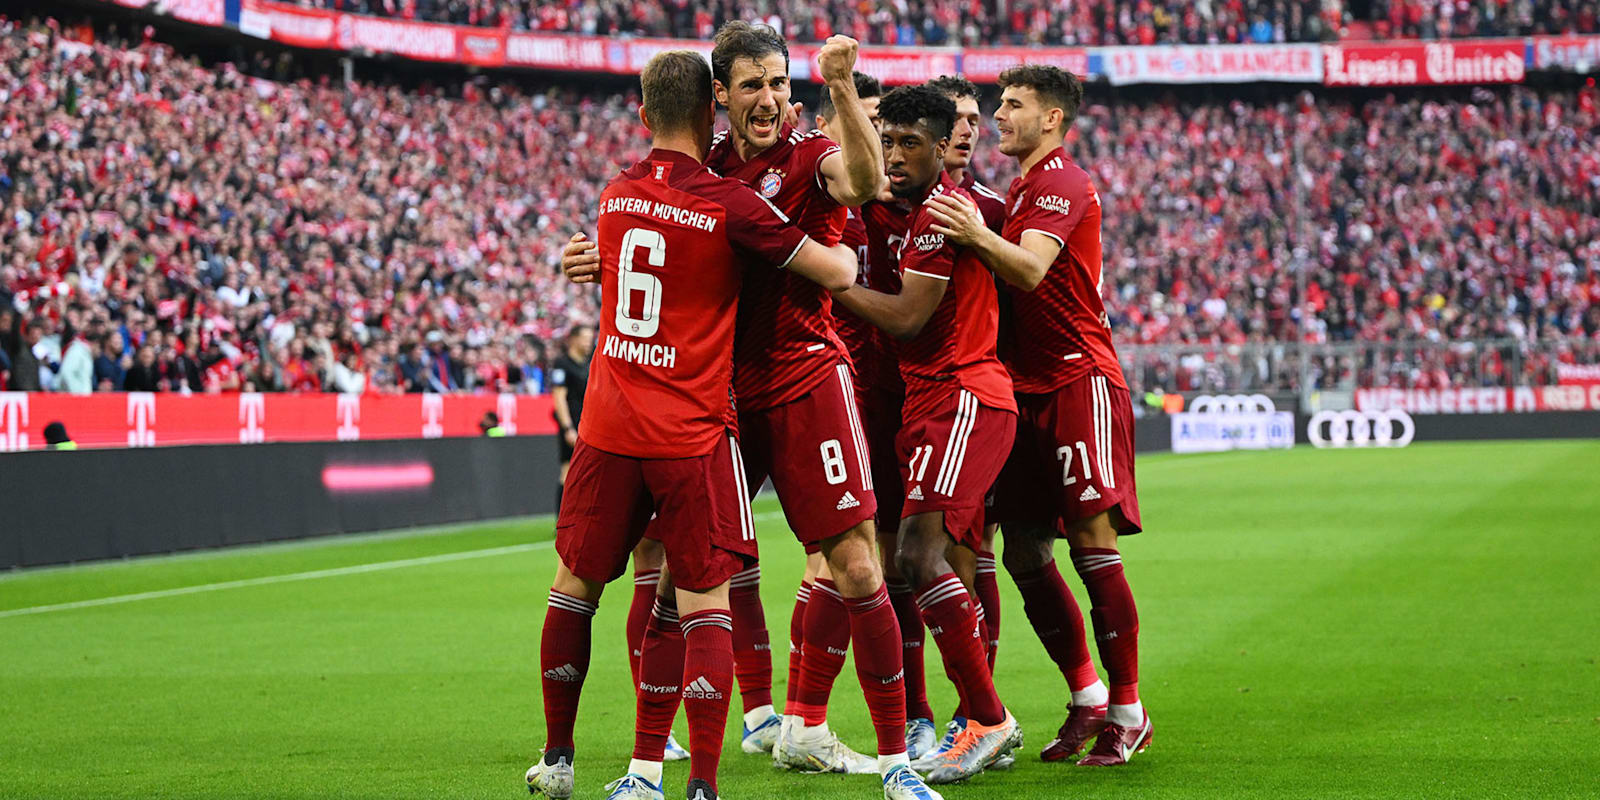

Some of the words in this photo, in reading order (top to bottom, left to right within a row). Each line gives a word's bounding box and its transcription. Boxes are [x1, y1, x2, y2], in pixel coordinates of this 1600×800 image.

[1323, 44, 1418, 85] Lipsia
[1425, 42, 1525, 82] United
[607, 197, 652, 215] BAYERN
[1035, 194, 1071, 209] QATAR
[913, 233, 945, 248] QATAR
[615, 228, 667, 338] 6
[602, 334, 677, 368] KIMMICH
[128, 393, 156, 447] T
[239, 393, 265, 444] T
[337, 393, 360, 441] T
[421, 393, 443, 438] T
[820, 439, 848, 485] 8
[908, 444, 934, 482] 11
[1056, 441, 1092, 486] 21
[836, 499, 861, 511] adidas
[543, 671, 581, 682] adida
[640, 681, 678, 693] BAYERN
[682, 691, 723, 700] adidas
